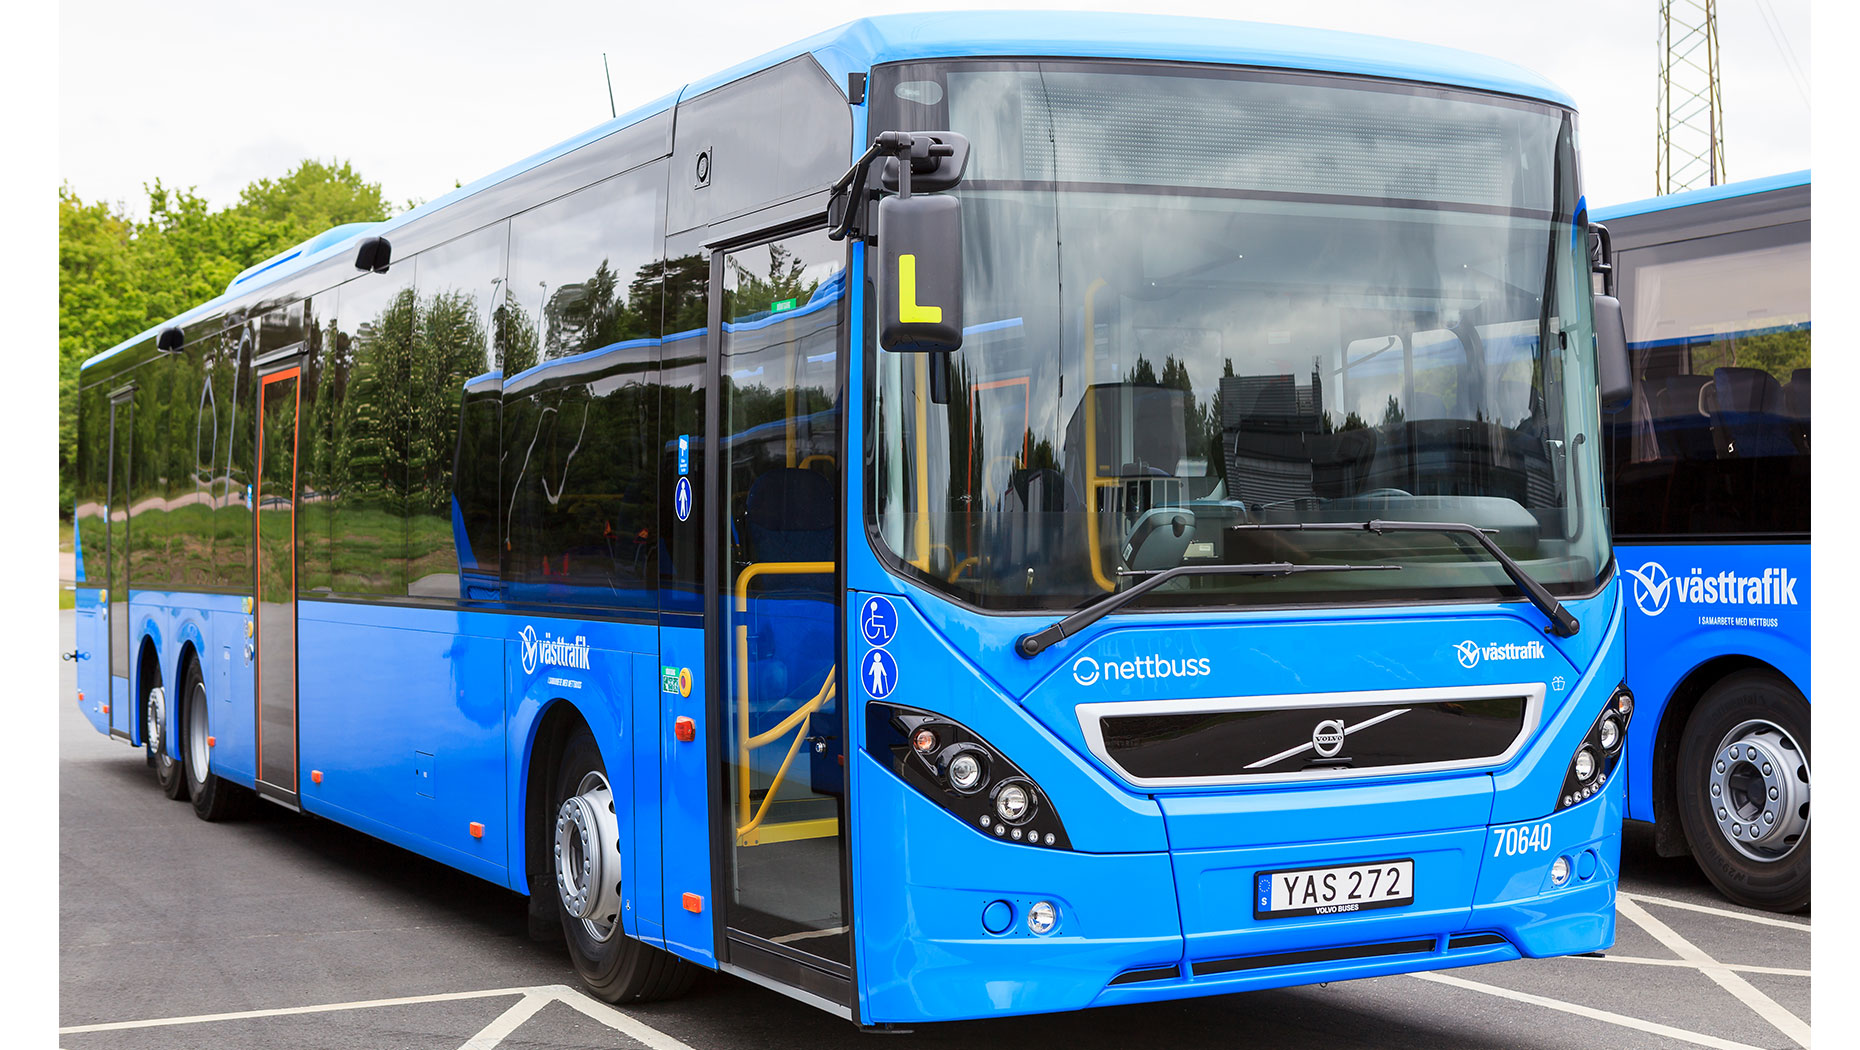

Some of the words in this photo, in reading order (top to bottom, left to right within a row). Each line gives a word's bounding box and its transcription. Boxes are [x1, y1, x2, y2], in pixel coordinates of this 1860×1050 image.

[899, 254, 942, 323] L
[1676, 568, 1798, 605] västtrafik
[1701, 616, 1735, 626] SAMARBETE
[1735, 617, 1748, 627] MED
[1748, 617, 1779, 628] NETTBUSS
[539, 632, 590, 670] västtrafik
[1104, 653, 1211, 680] nettbuss
[1481, 641, 1545, 661] västtrafik
[1493, 822, 1552, 858] 70640
[1261, 897, 1268, 906] S
[1283, 873, 1337, 906] YAS
[1347, 867, 1400, 900] 272
[1315, 906, 1337, 915] VOLVO
[1337, 903, 1359, 913] BUSES
